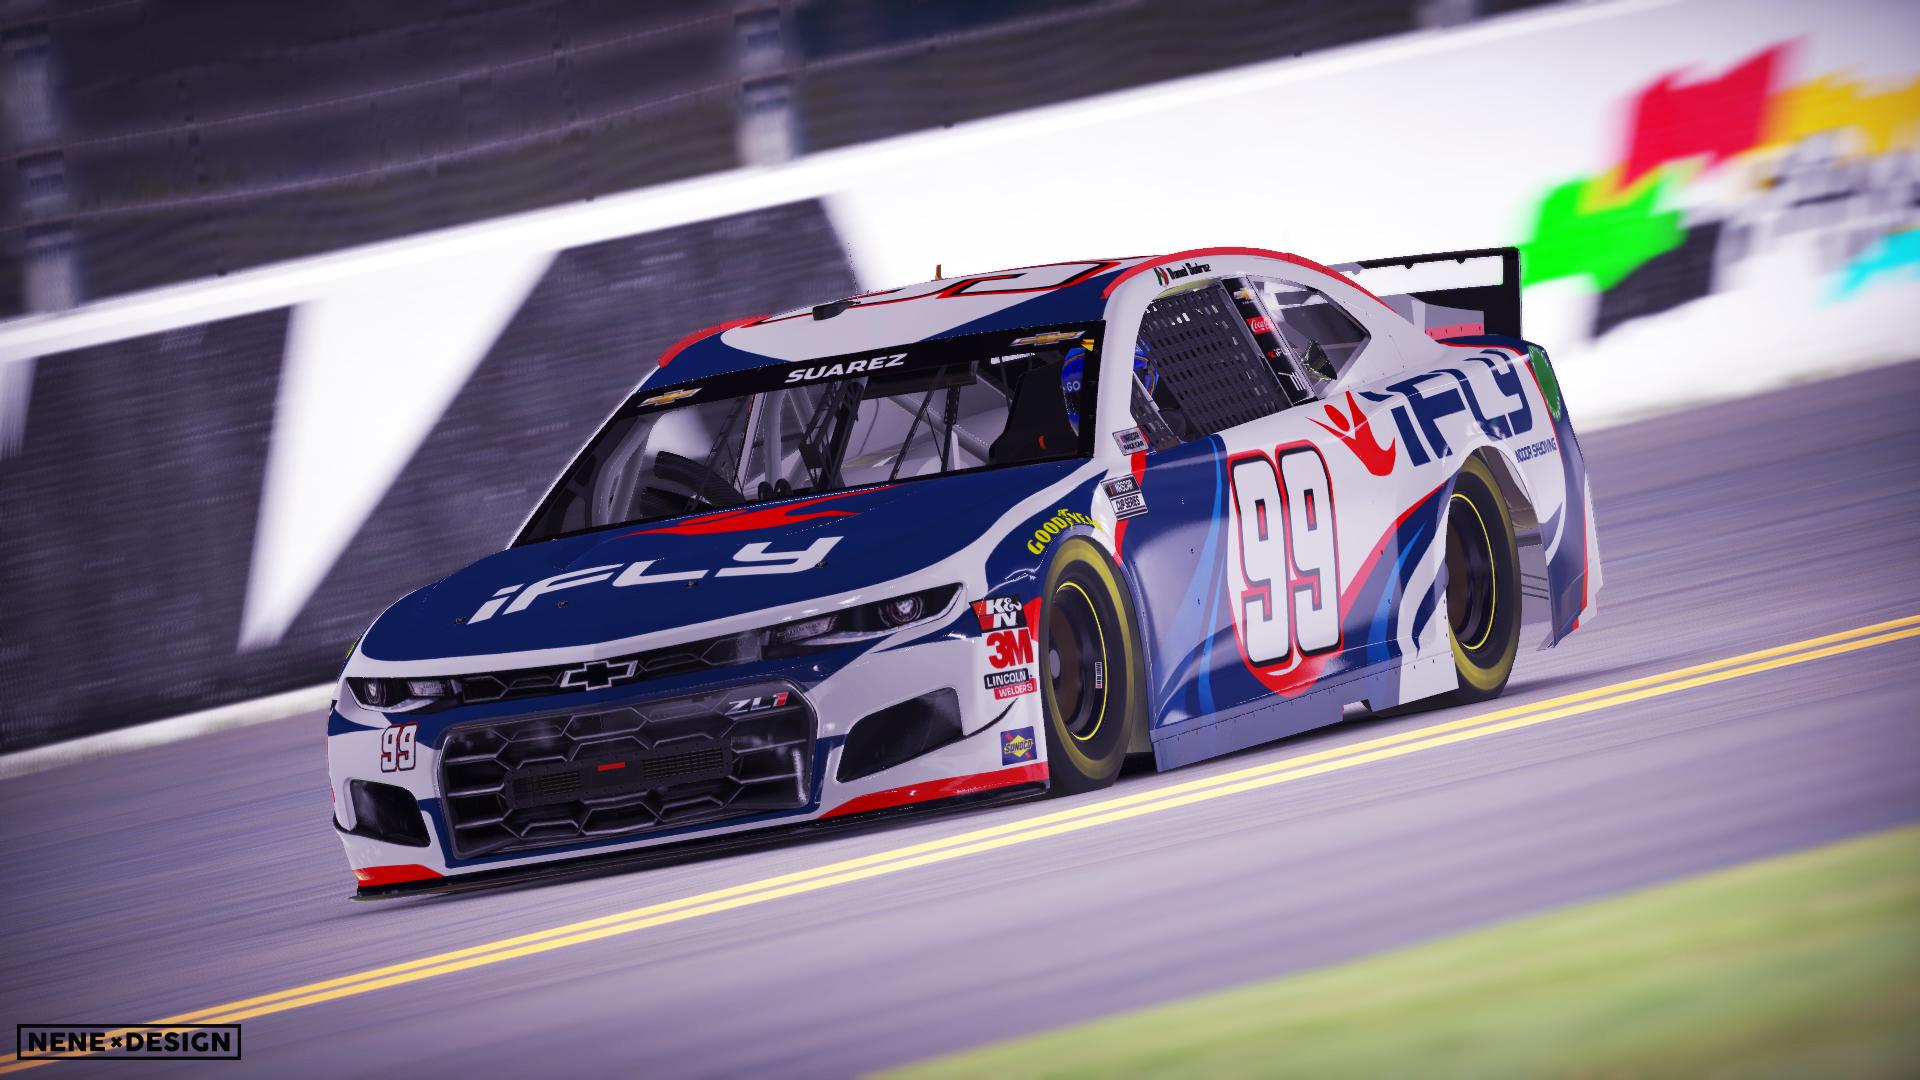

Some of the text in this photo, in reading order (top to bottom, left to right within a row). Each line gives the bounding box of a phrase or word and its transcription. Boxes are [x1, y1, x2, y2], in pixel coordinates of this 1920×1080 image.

[784, 353, 908, 384] SUAREZ
[1228, 441, 1344, 669] 99
[986, 628, 1034, 669] 3M
[986, 671, 1027, 687] LINCOLN
[998, 682, 1033, 698] WELDERS
[724, 691, 789, 716] ZL1
[381, 721, 418, 773] 99
[1004, 738, 1034, 754] SUNOCO
